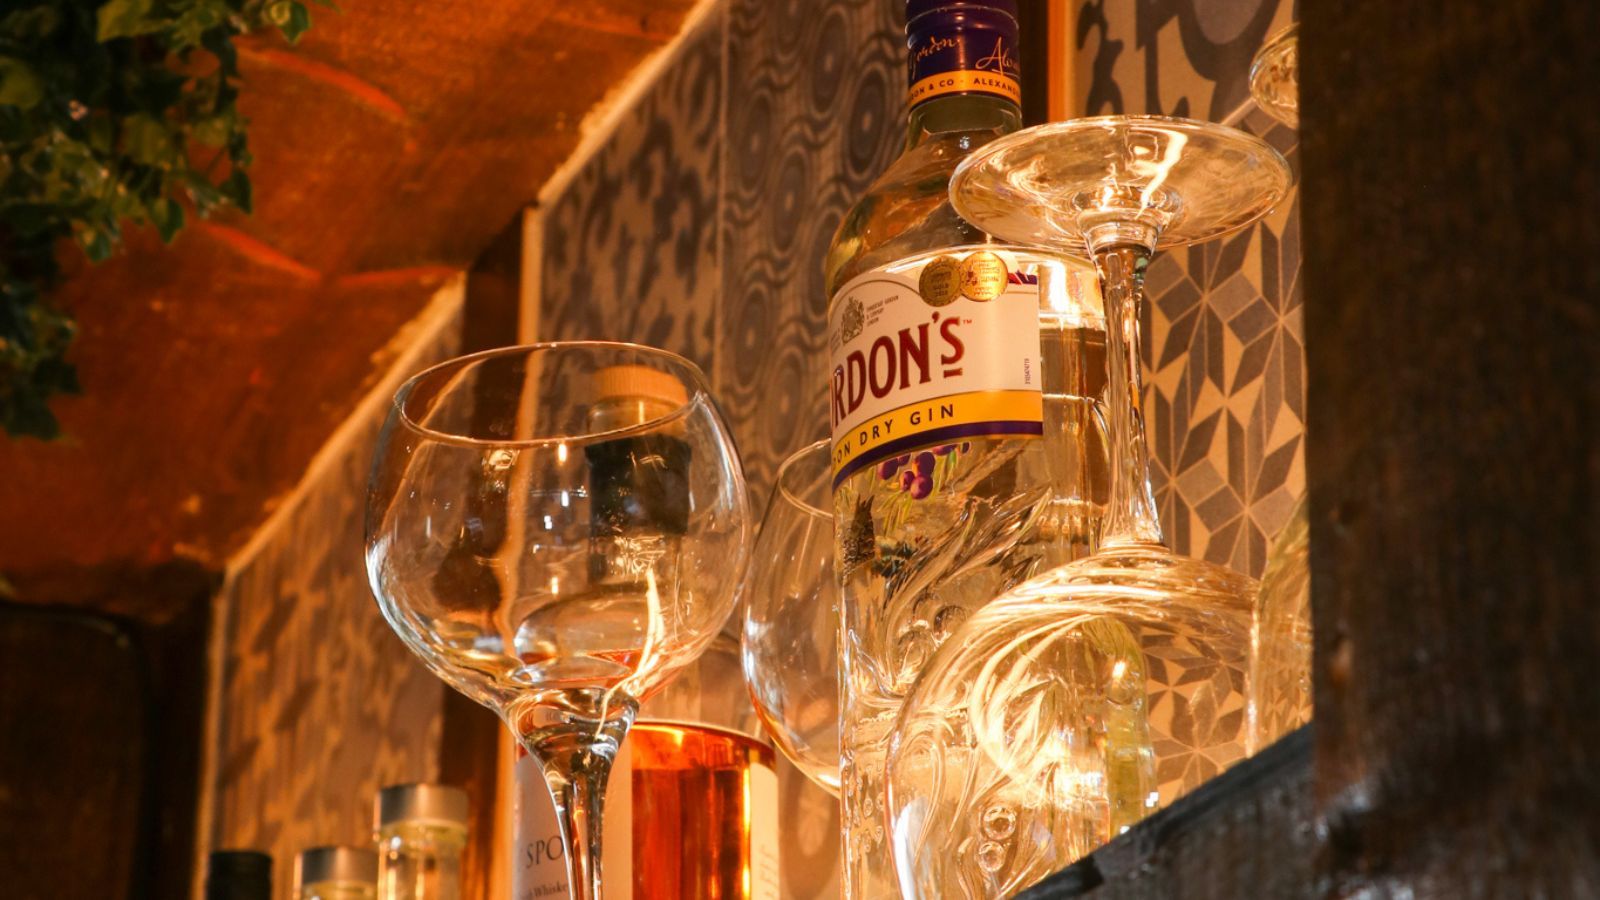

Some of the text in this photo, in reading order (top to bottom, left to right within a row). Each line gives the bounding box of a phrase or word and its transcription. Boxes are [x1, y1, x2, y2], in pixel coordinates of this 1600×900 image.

[939, 79, 954, 87] CO
[832, 311, 965, 427] RDON'S
[833, 404, 954, 464] ON DRY GIN
[526, 835, 565, 869] SPO
[533, 881, 568, 898] Whiske
